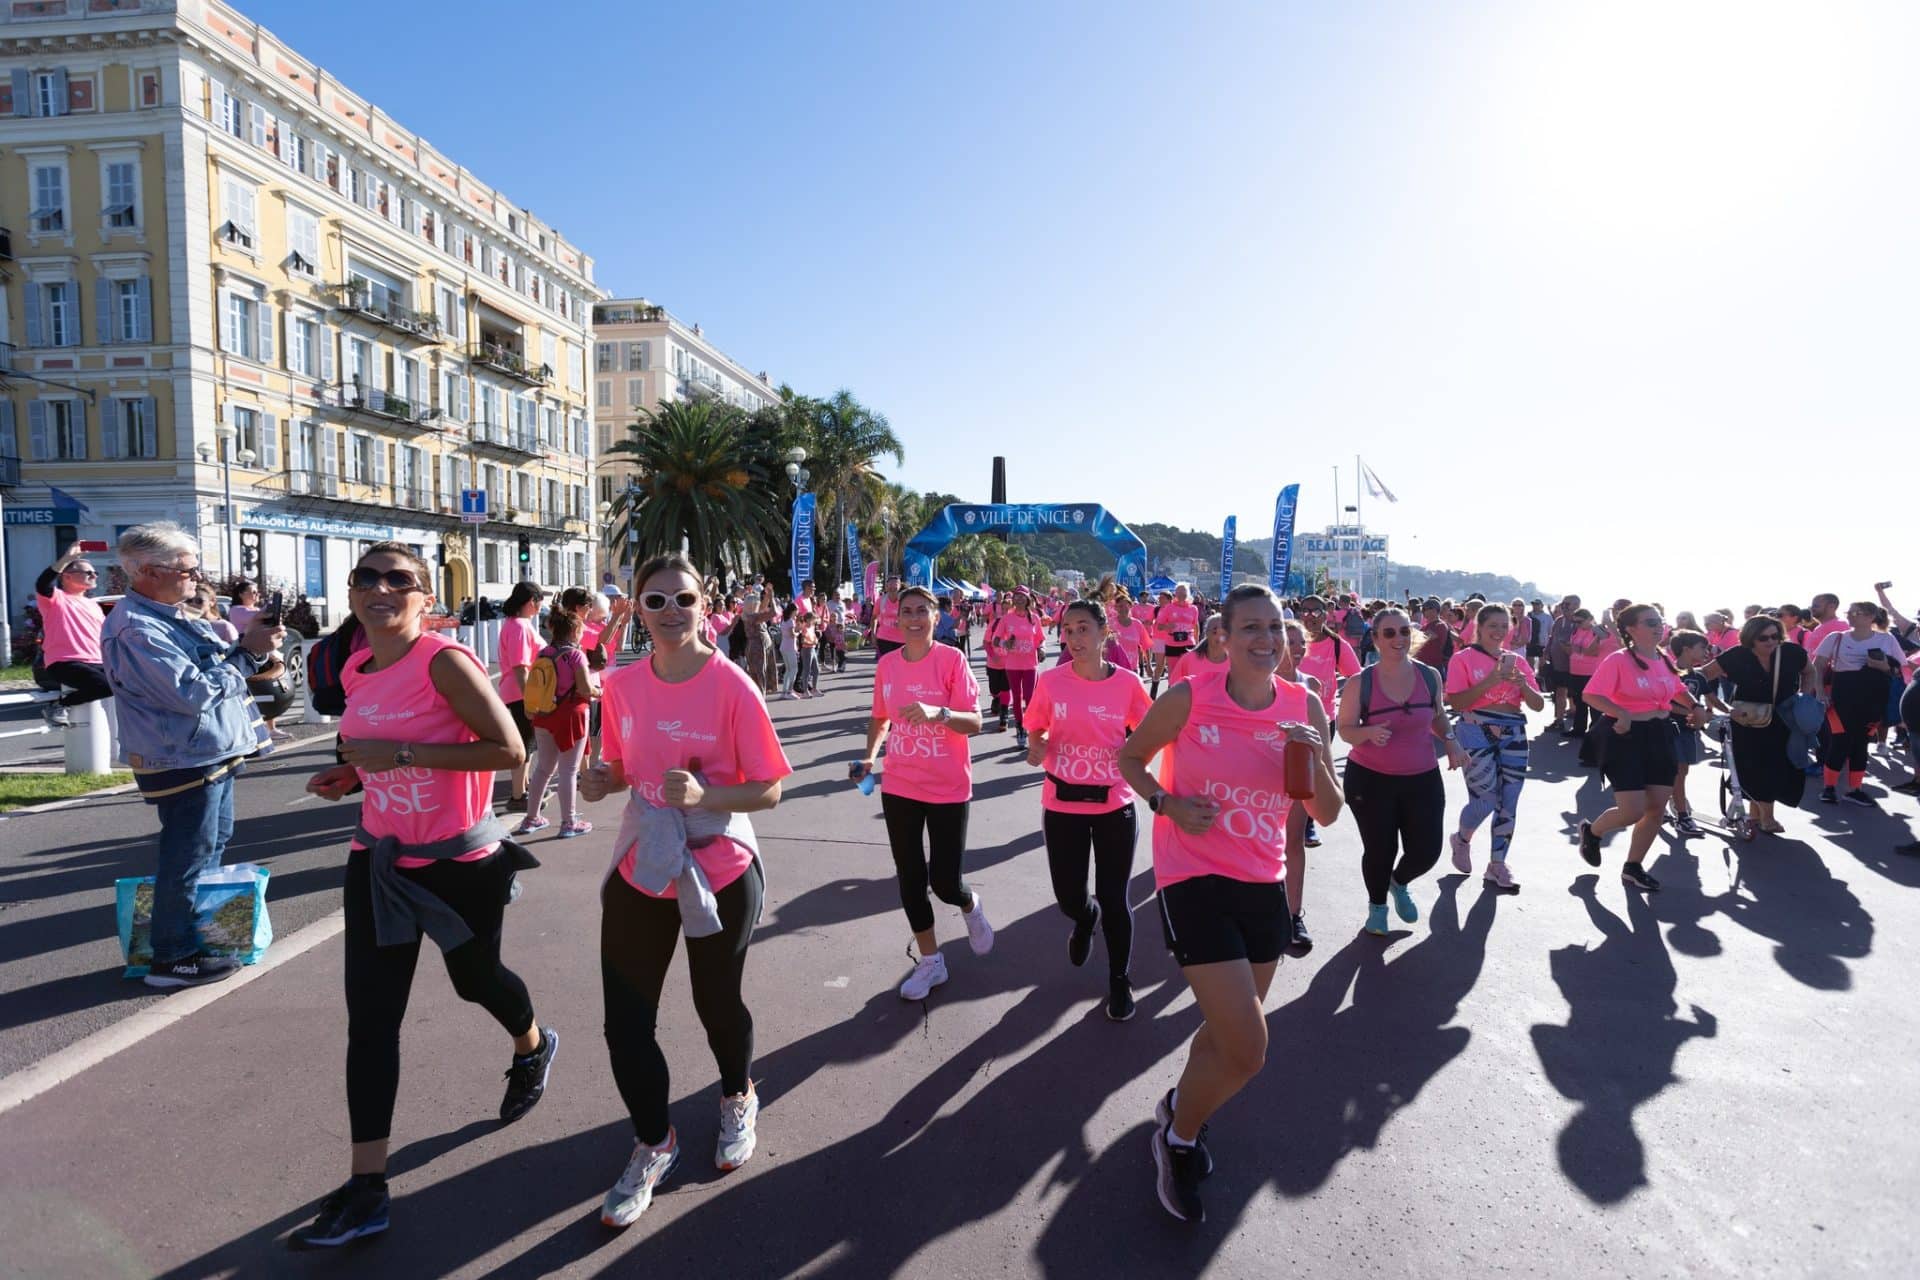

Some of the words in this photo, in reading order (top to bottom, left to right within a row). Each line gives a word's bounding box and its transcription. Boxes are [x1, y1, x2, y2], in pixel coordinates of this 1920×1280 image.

[4, 510, 54, 522] ITIMES
[242, 514, 285, 528] MAISON
[288, 519, 308, 529] DES
[310, 522, 388, 538] ALPES-MARITIMES
[798, 511, 810, 538] NICE
[980, 511, 1013, 525] VILLE
[1017, 511, 1035, 524] DE
[1037, 510, 1070, 524] NICE
[1280, 503, 1294, 532] NICE
[798, 541, 810, 556] DE
[798, 559, 810, 581] ILLE
[1054, 703, 1067, 719] N
[890, 734, 949, 758] ROSE
[1200, 725, 1220, 745] N
[1055, 754, 1121, 780] ROSE
[363, 780, 440, 815] OSE
